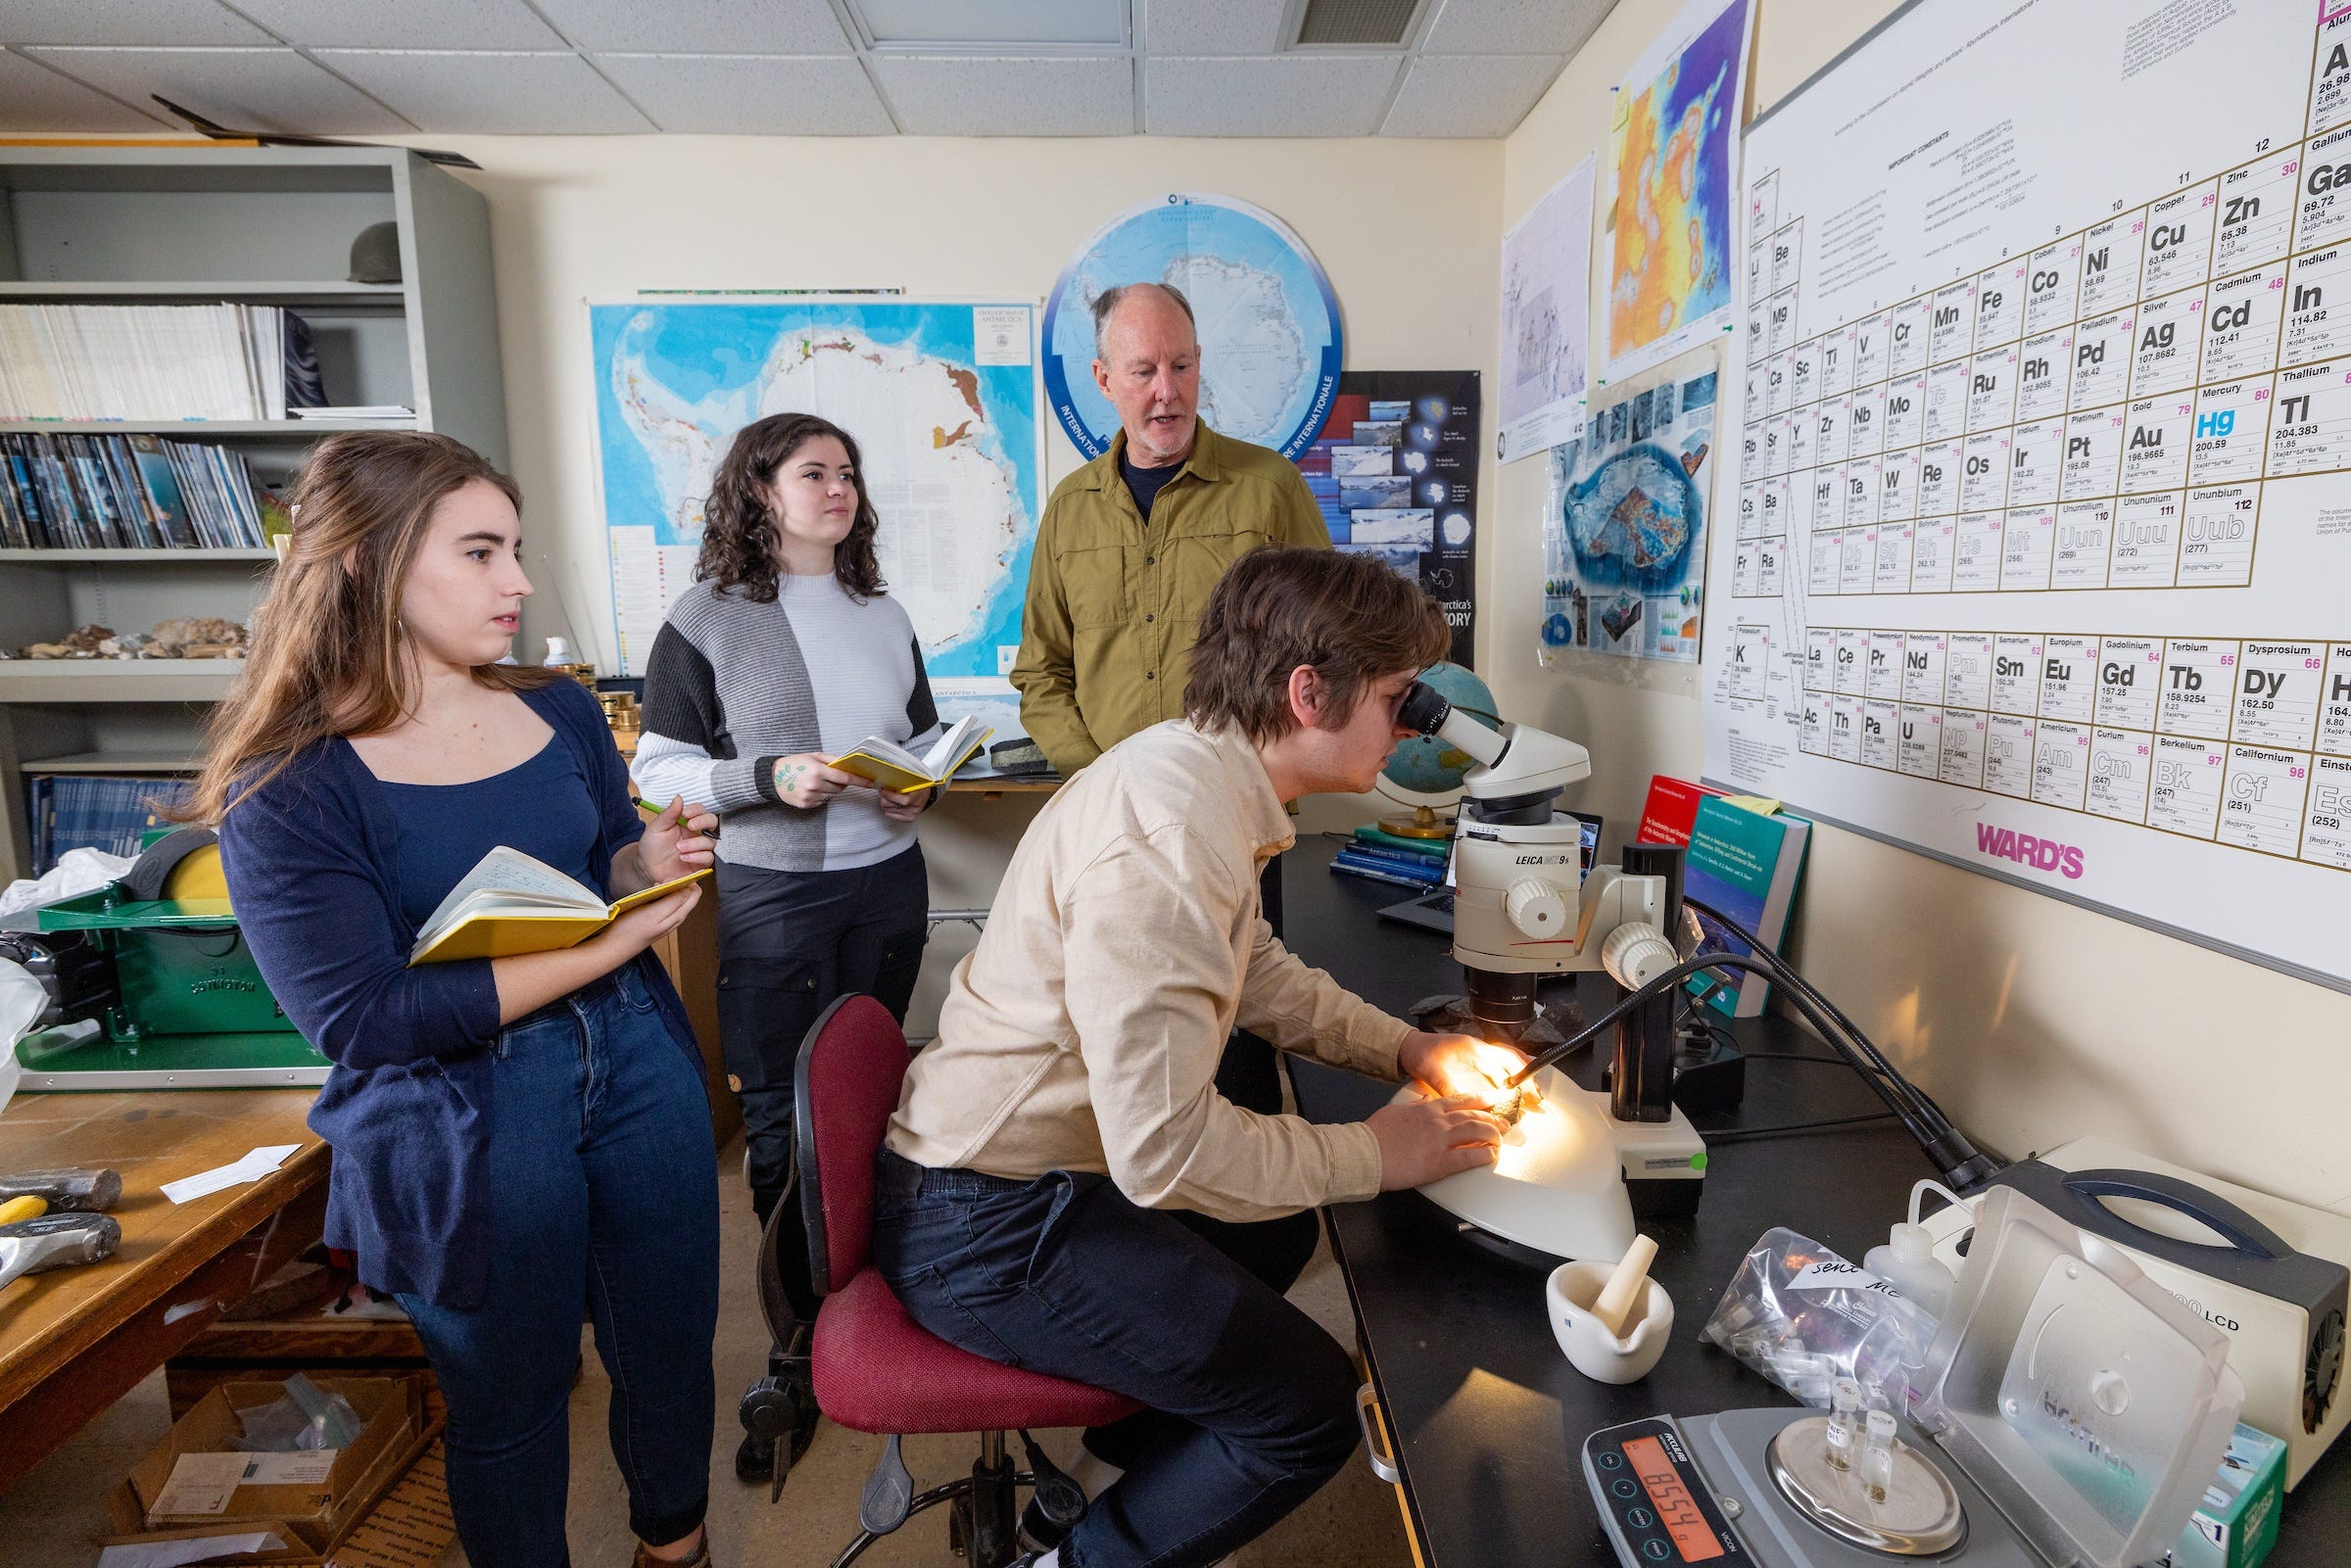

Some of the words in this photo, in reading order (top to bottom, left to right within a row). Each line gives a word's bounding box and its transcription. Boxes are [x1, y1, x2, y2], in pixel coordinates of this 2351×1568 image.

[2323, 43, 2349, 78] A
[2319, 72, 2350, 94] 26.98
[1918, 130, 1949, 154] CONSTANTS
[2255, 138, 2270, 153] 12
[2178, 171, 2190, 184] 11
[2227, 169, 2248, 184] Zinc
[2281, 162, 2297, 177] 30
[2307, 164, 2351, 196] Ga
[2154, 194, 2185, 214] Copper
[2201, 194, 2215, 208] 29
[2304, 195, 2334, 214] 69.72
[2223, 196, 2260, 227] Zn
[2089, 222, 2114, 237] Nickel
[2132, 220, 2143, 234] 28
[2221, 226, 2248, 241] 65.38
[2151, 224, 2185, 251] Cu
[1775, 246, 1789, 263] Be
[2034, 246, 2056, 261] Cobalt
[2087, 247, 2110, 275] Ni
[2148, 250, 2177, 266] 63.546
[2298, 250, 2337, 268] Indium
[2032, 271, 2059, 294] Co
[2215, 272, 2261, 293] Cadmium
[2268, 276, 2283, 291] 48
[1981, 290, 2002, 312] Fe
[2143, 301, 2168, 313] Silver
[2189, 300, 2203, 312] 47
[2293, 285, 2323, 312] In
[1773, 306, 1788, 325] Mg
[1935, 307, 1959, 329] Mn
[2081, 314, 2118, 331] Palladium
[2211, 300, 2251, 332] Cd
[2291, 310, 2327, 327] 114.82
[1895, 323, 1910, 342] Cr
[2121, 320, 2133, 331] 46
[2289, 328, 2306, 338] 7.31
[2139, 322, 2175, 352] Ag
[2209, 332, 2240, 347] 112.41
[2077, 340, 2106, 367] Pd
[2139, 349, 2176, 363] 107.8682
[2023, 358, 2048, 382] Rh
[2282, 365, 2330, 382] Thallium
[1973, 374, 1995, 395] Ru
[2202, 383, 2242, 399] Mercury
[2255, 389, 2270, 402] 80
[1293, 375, 1333, 450] INTERNATIONALE
[1889, 398, 1910, 416] Mo
[2133, 402, 2152, 412] Gold
[2178, 404, 2190, 415] 79
[2280, 396, 2310, 424] Tl
[1854, 407, 1871, 425] Nb
[2072, 411, 2104, 424] Platinum
[2111, 417, 2123, 427] 78
[2196, 409, 2235, 439] Hg
[2129, 425, 2162, 451] Au
[2276, 425, 2319, 440] 204.383
[2068, 437, 2090, 459] Pt
[2195, 440, 2227, 452] 200.59
[1966, 456, 1990, 476] Os
[2015, 448, 2028, 467] Ir
[1886, 470, 1899, 489] W
[1923, 464, 1943, 484] Re
[1850, 479, 1862, 495] Ta
[2193, 488, 2242, 500] Ununbium
[2124, 494, 2172, 506] Unununium
[2234, 499, 2252, 510] 112
[2160, 505, 2175, 516] 111
[2118, 522, 2167, 546] Uuu
[2187, 514, 2244, 542] Uub
[2060, 527, 2102, 549] Uun
[2117, 547, 2137, 557] (272)
[2184, 544, 2208, 554] (277)
[1442, 599, 1471, 609] arctica's
[1808, 645, 1821, 661] La
[1838, 646, 1853, 664] Ce
[2172, 642, 2208, 652] Terbium
[2248, 644, 2311, 655] Dysprosium
[1871, 649, 1886, 666] Pr
[1907, 651, 1928, 670] Nd
[1996, 655, 2024, 677] Sm
[2220, 655, 2234, 666] 65
[2305, 658, 2321, 669] 66
[2045, 659, 2071, 681] Eu
[2102, 662, 2135, 687] Gd
[2169, 666, 2202, 691] Tb
[2243, 669, 2286, 698] Dy
[2241, 699, 2275, 710] 162.50
[1865, 716, 1881, 735] Pa
[2160, 738, 2205, 751] Berkelium
[2037, 743, 2073, 768] Am
[2208, 755, 2223, 766] 97
[2235, 748, 2294, 764] Californium
[2093, 751, 2132, 779] Cm
[2289, 767, 2305, 779] 98
[2156, 760, 2191, 790] Bk
[2231, 772, 2268, 802] Cf
[2312, 815, 2340, 830] (252)
[1368, 848, 1401, 860] Antarctica
[1977, 822, 2085, 879] WARD'S
[1515, 856, 1543, 865] LEICA
[2205, 1310, 2239, 1332] LCD
[1663, 1433, 1687, 1463] ACCULAB
[1634, 1509, 1647, 1526] ENTER
[2214, 1524, 2222, 1542] 1
[1652, 1542, 1663, 1557] PRINT
[1721, 1532, 1738, 1553] VICON
